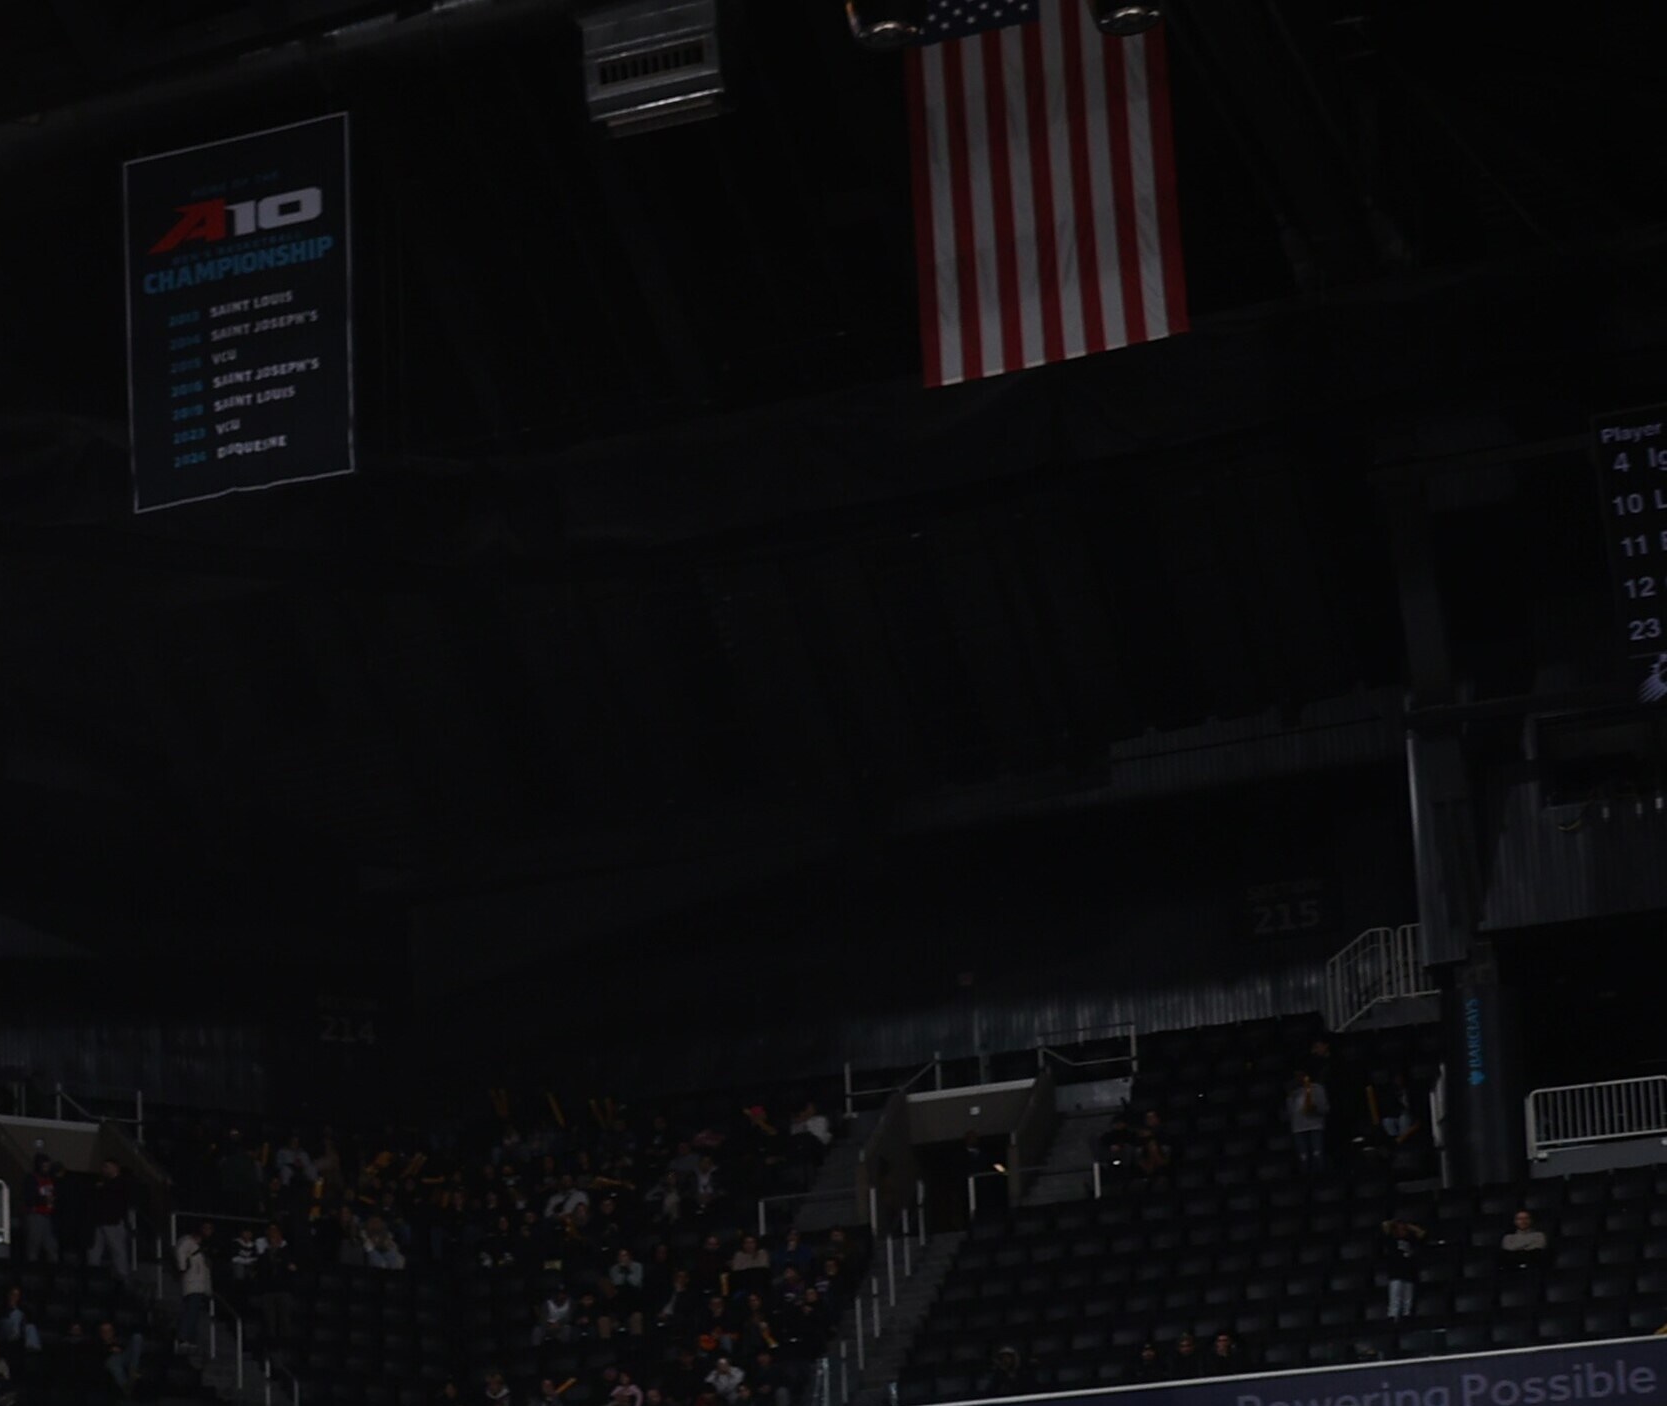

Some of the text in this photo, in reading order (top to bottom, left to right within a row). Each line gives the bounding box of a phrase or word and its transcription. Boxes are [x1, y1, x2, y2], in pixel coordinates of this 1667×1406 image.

[147, 186, 322, 255] A10
[143, 235, 334, 295] CHAMPIONSHIP
[210, 298, 251, 318] SAINT
[253, 290, 293, 309] LOUIS
[211, 308, 318, 341] SAINT JOSEPH'S
[212, 369, 252, 389] SAINT
[254, 356, 320, 381] JOSEPH'S
[214, 393, 253, 412] SAINT
[255, 385, 296, 404] LOUIS
[1600, 423, 1662, 444] Player
[1612, 451, 1631, 472] 4
[1612, 492, 1645, 516] 10
[1619, 533, 1649, 557] 11
[1623, 575, 1657, 599] 12
[1627, 618, 1662, 640] 23
[1253, 898, 1322, 935] 215
[319, 1014, 376, 1044] 214
[1465, 998, 1482, 1067] BARCLAYS
